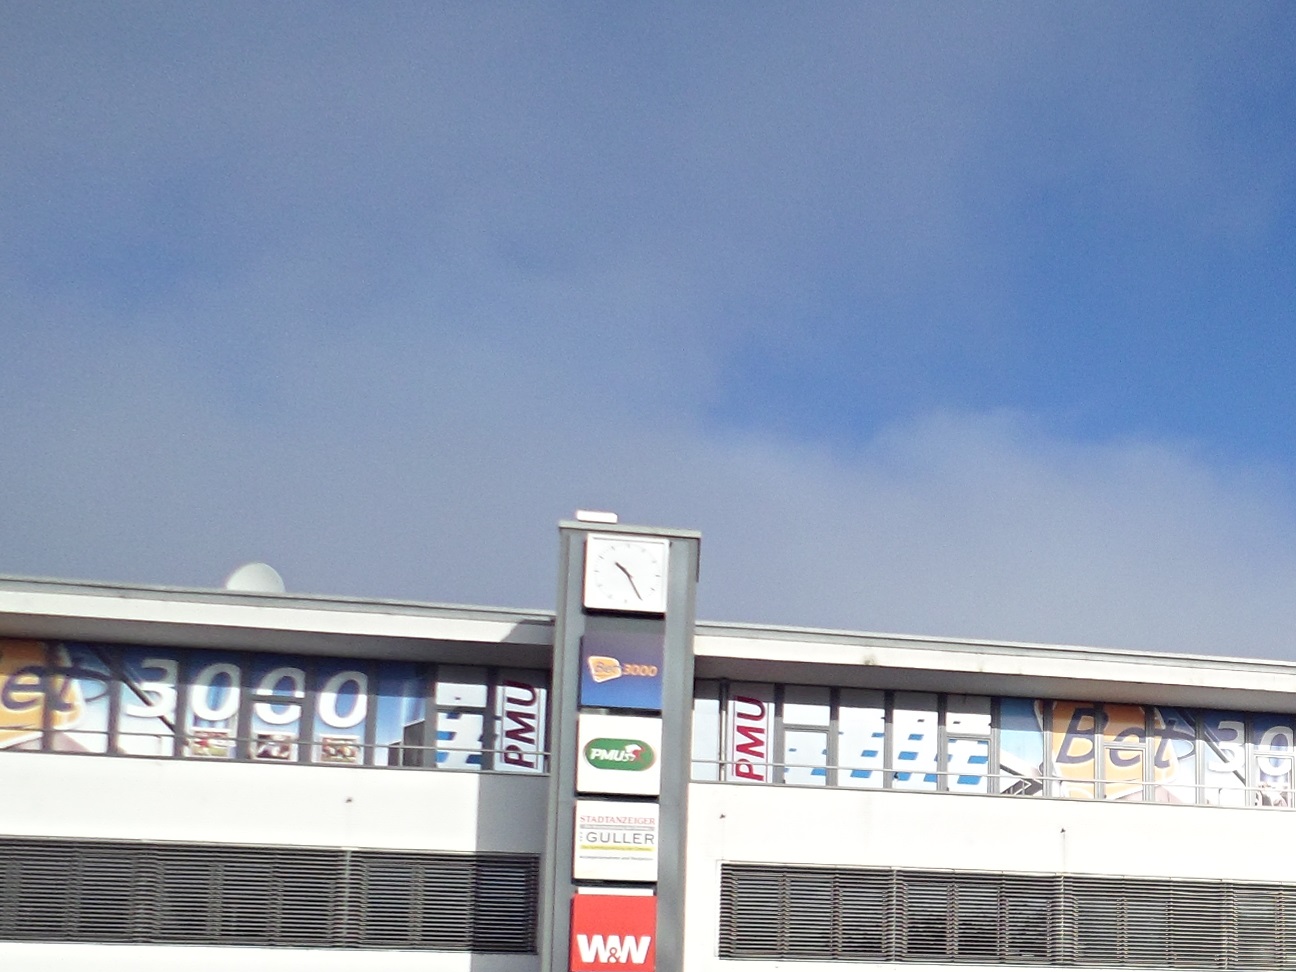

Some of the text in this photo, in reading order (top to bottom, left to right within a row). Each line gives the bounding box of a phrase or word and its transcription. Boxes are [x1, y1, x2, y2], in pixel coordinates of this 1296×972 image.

[623, 663, 658, 677] 3000
[126, 658, 368, 729] 3000
[503, 681, 539, 769] PMU
[735, 696, 766, 782] PMU
[1056, 706, 1195, 769] Bet
[580, 816, 655, 825] STADTANZEIGER
[586, 831, 655, 844] GULLER
[576, 934, 651, 964] W&W
